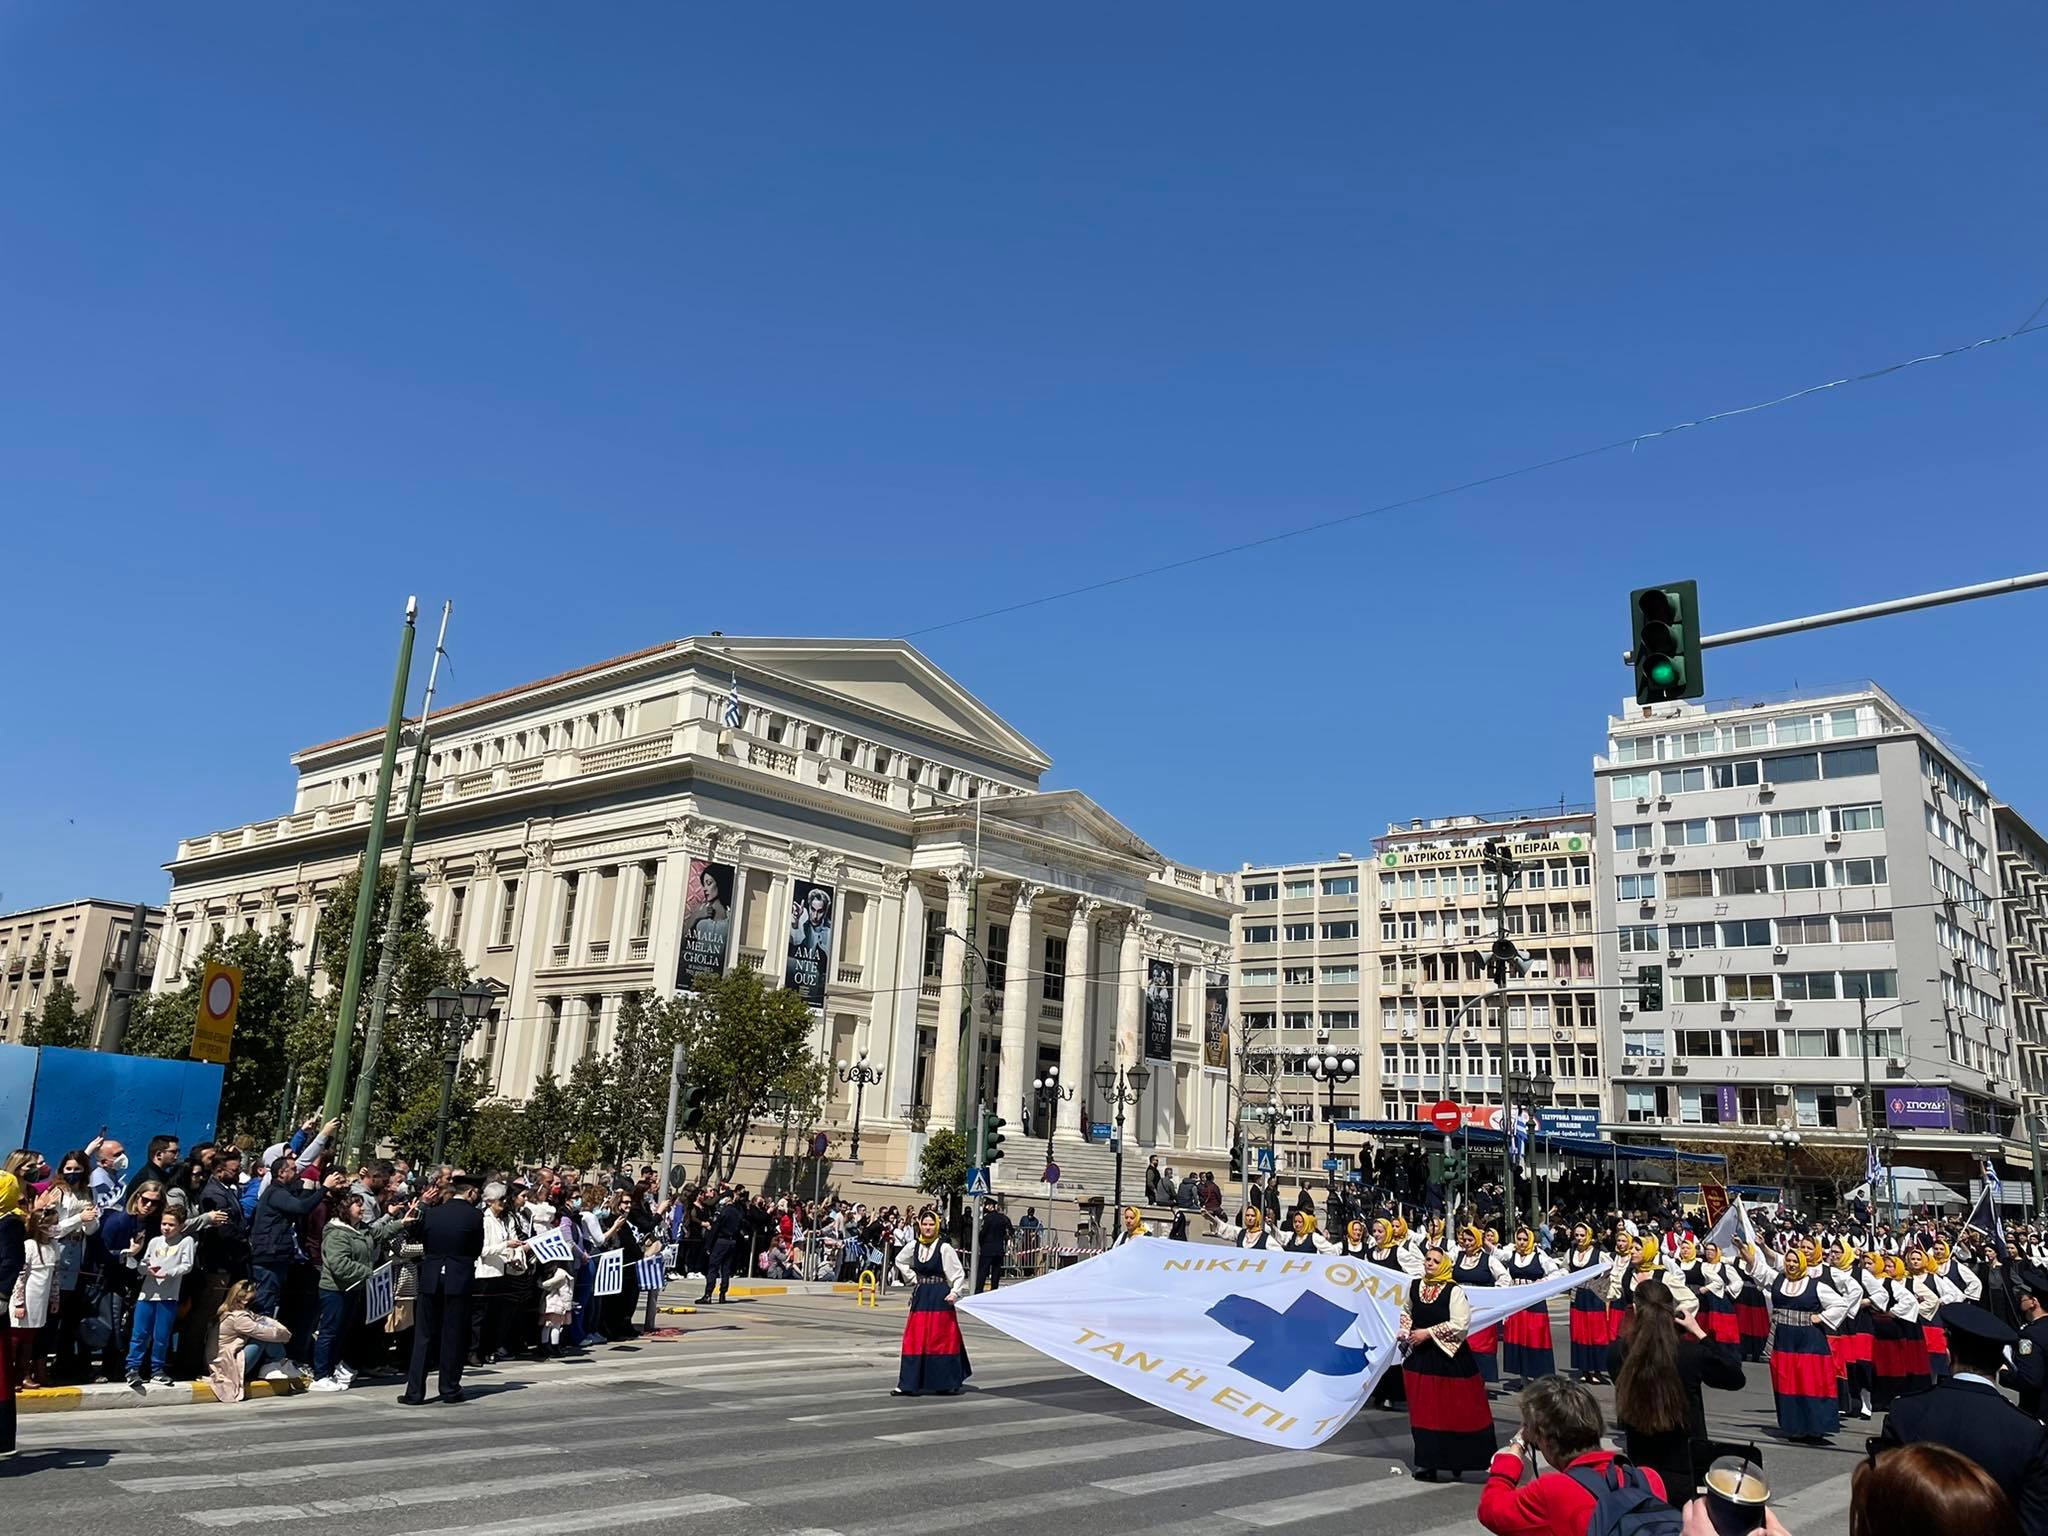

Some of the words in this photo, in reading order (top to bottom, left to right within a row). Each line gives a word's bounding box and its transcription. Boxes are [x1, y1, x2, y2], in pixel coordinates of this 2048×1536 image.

[1403, 850, 1451, 864] ΙΑΤΡΙΚΟΣ
[1515, 841, 1560, 854] ΠΕΙΡΑΙΑ
[685, 940, 721, 954] MELAN
[794, 946, 821, 961] ΑΜΑ
[794, 959, 819, 973] ΝΤΕ
[1906, 1101, 1945, 1110] ΣΠΟΥΔΗ
[1162, 1258, 1268, 1273] ΝΙΚΗ
[1072, 1327, 1164, 1373] ΤΑΝ
[1210, 1386, 1298, 1432] ΕΠΙ
